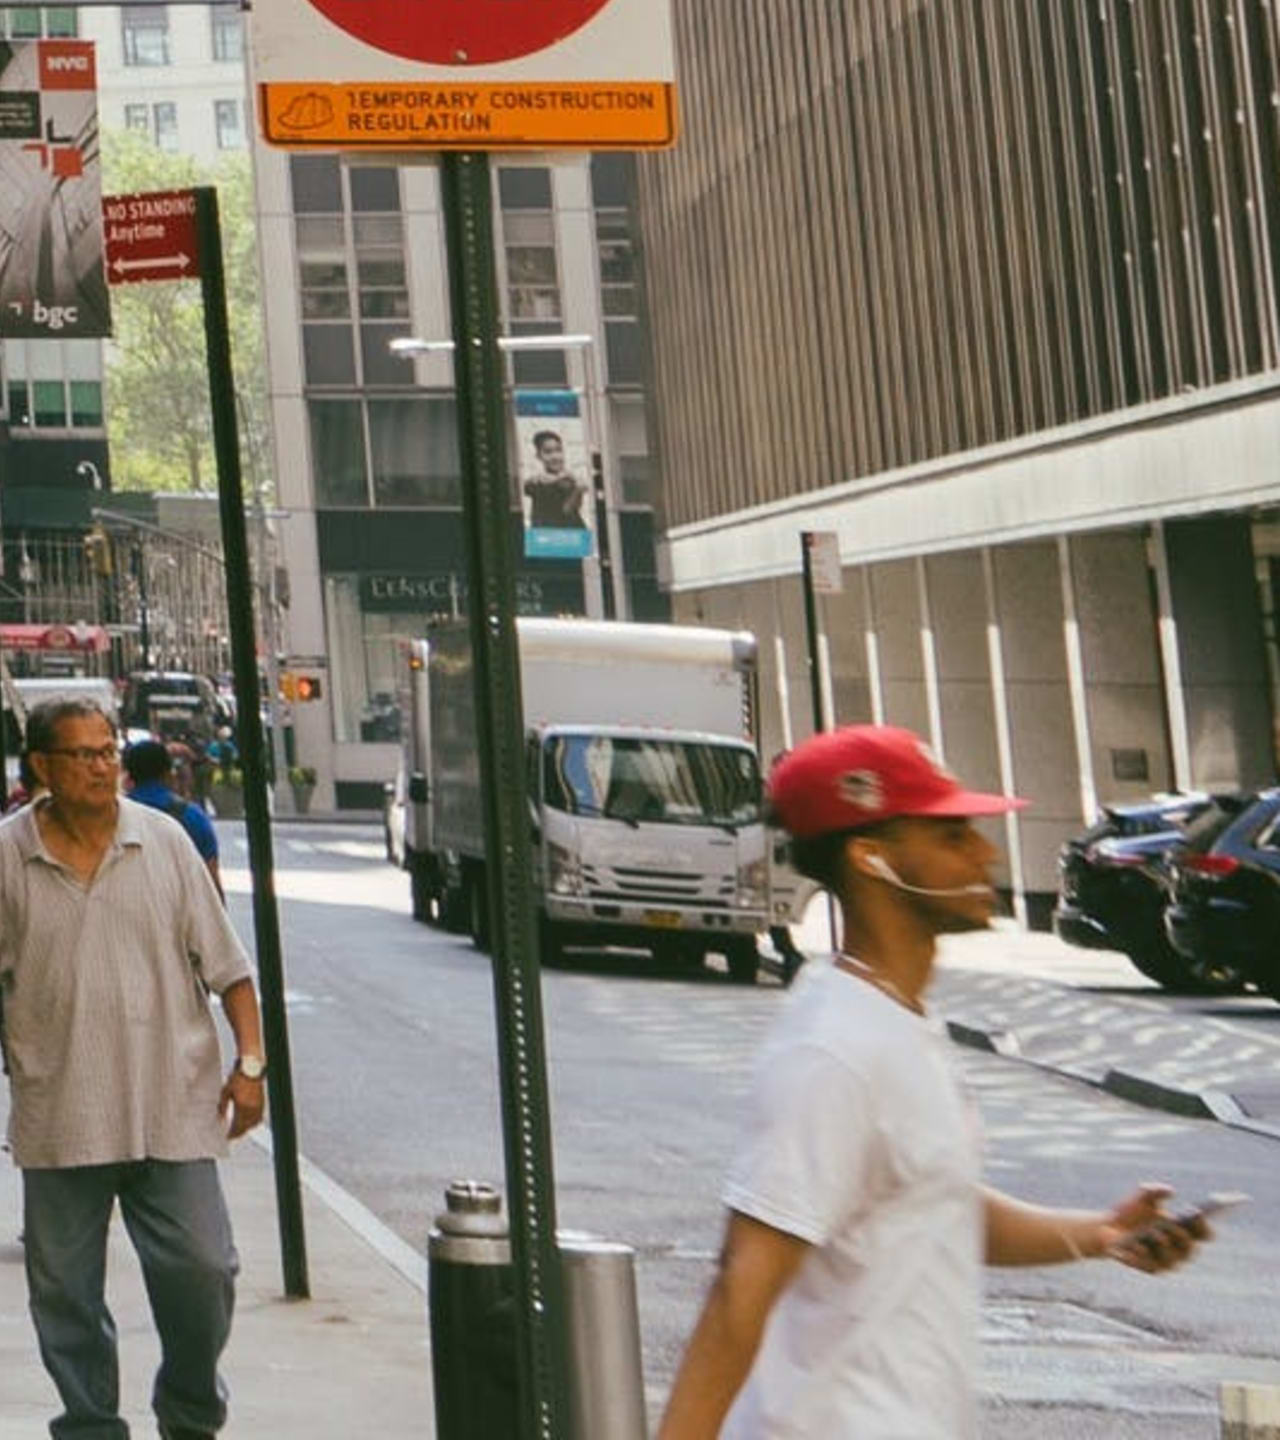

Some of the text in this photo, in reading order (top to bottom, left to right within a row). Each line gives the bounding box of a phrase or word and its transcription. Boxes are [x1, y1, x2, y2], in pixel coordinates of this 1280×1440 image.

[347, 90, 654, 109] TEMPORARY CONSTRUCTION
[347, 113, 491, 131] REGULATION
[107, 197, 196, 220] NO STANDING
[111, 224, 165, 244] Anytime
[34, 299, 78, 329] bgc
[371, 575, 542, 598] LENSCRS
